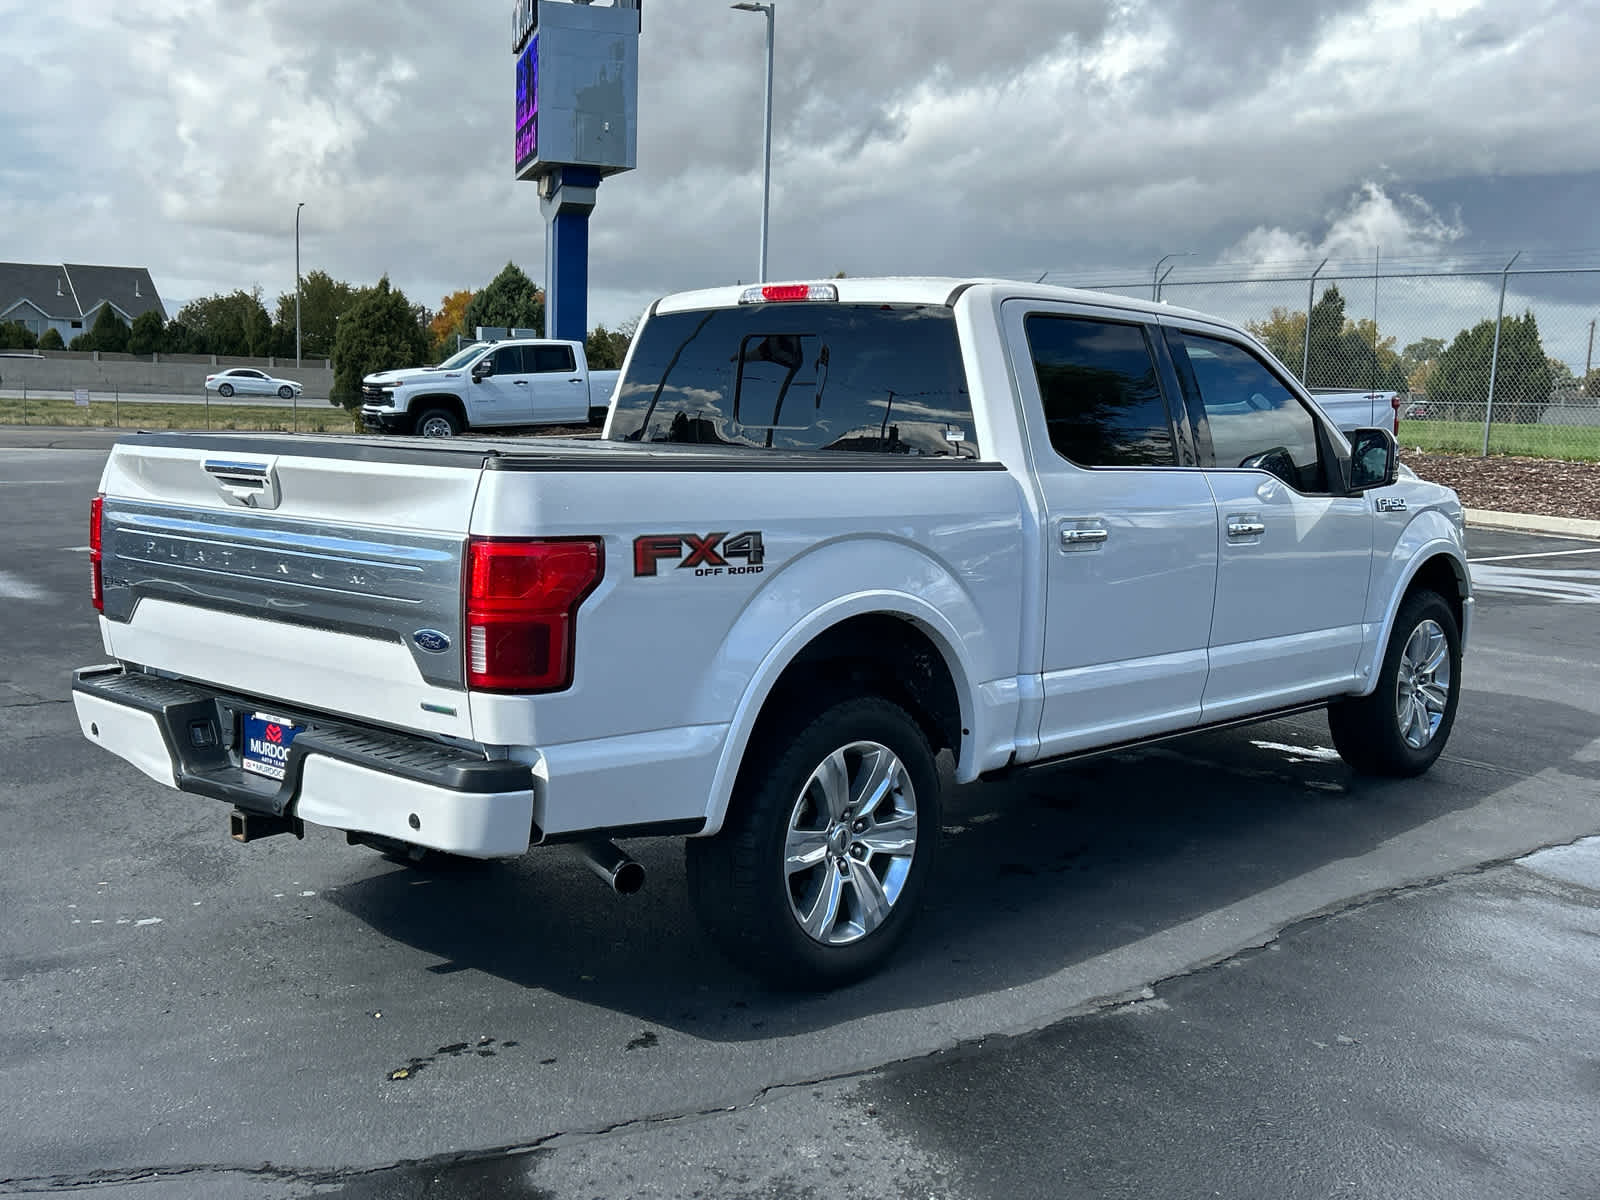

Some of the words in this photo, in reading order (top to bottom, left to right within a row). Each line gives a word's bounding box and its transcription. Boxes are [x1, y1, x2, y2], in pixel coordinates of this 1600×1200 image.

[633, 531, 765, 578] FX4
[695, 568, 723, 576] OFF
[728, 566, 764, 575] ROAD
